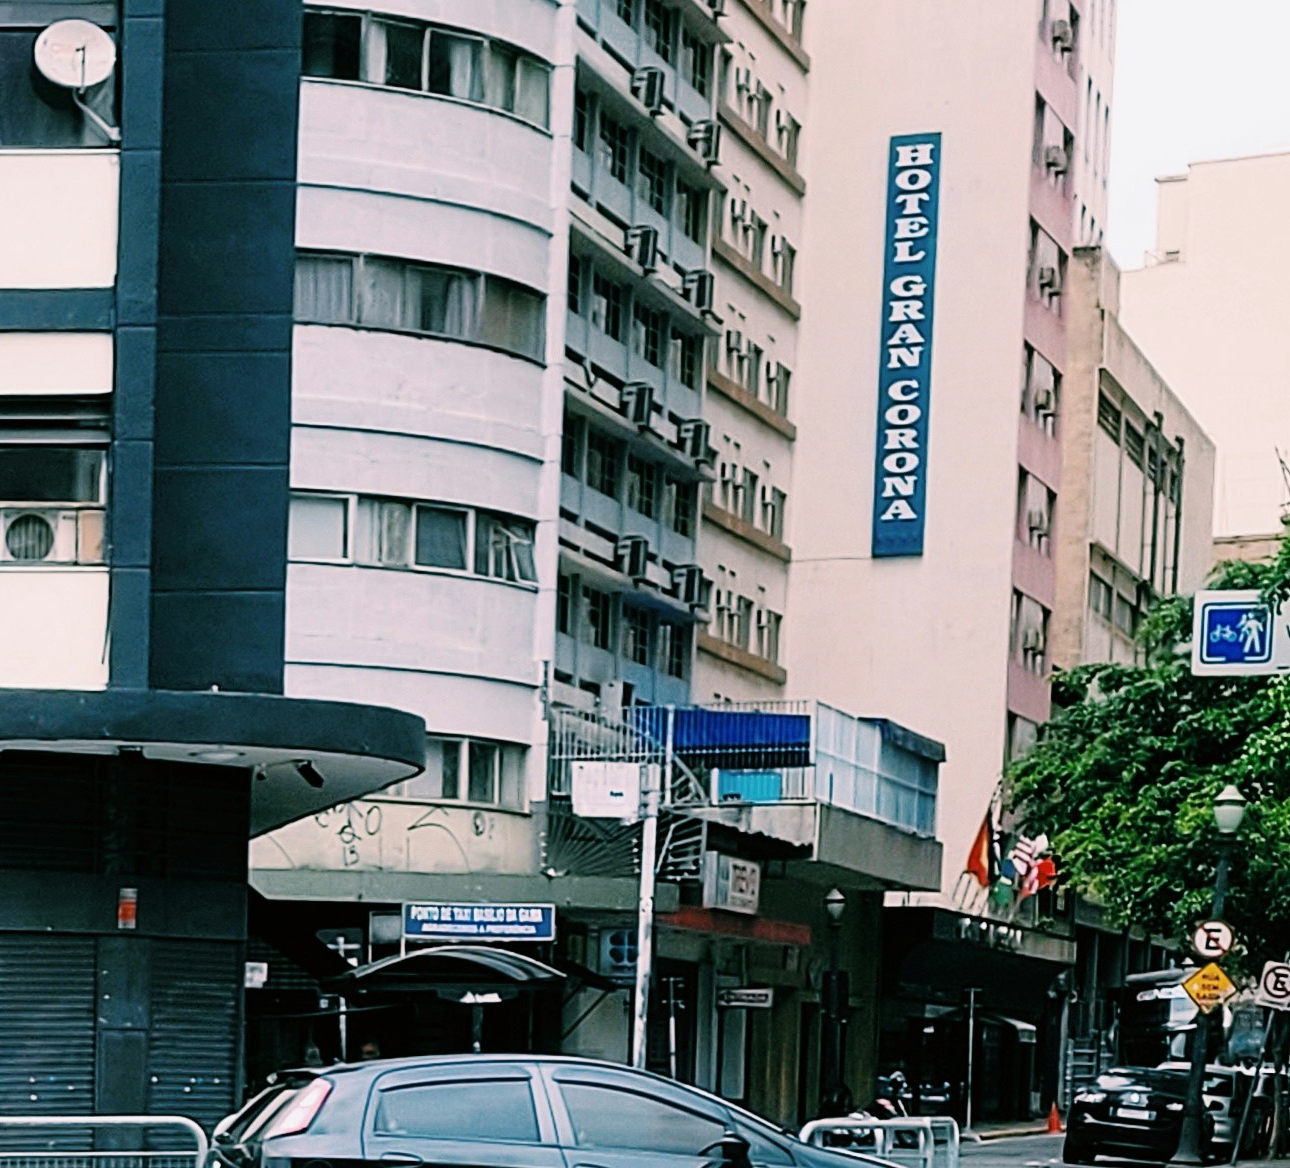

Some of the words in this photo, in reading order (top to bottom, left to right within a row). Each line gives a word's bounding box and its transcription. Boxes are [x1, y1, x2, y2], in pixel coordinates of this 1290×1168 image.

[894, 143, 935, 262] HOTEL
[888, 275, 927, 368] GRAN
[880, 379, 921, 520] CORONA
[1204, 928, 1222, 951] E
[1272, 973, 1289, 992] E
